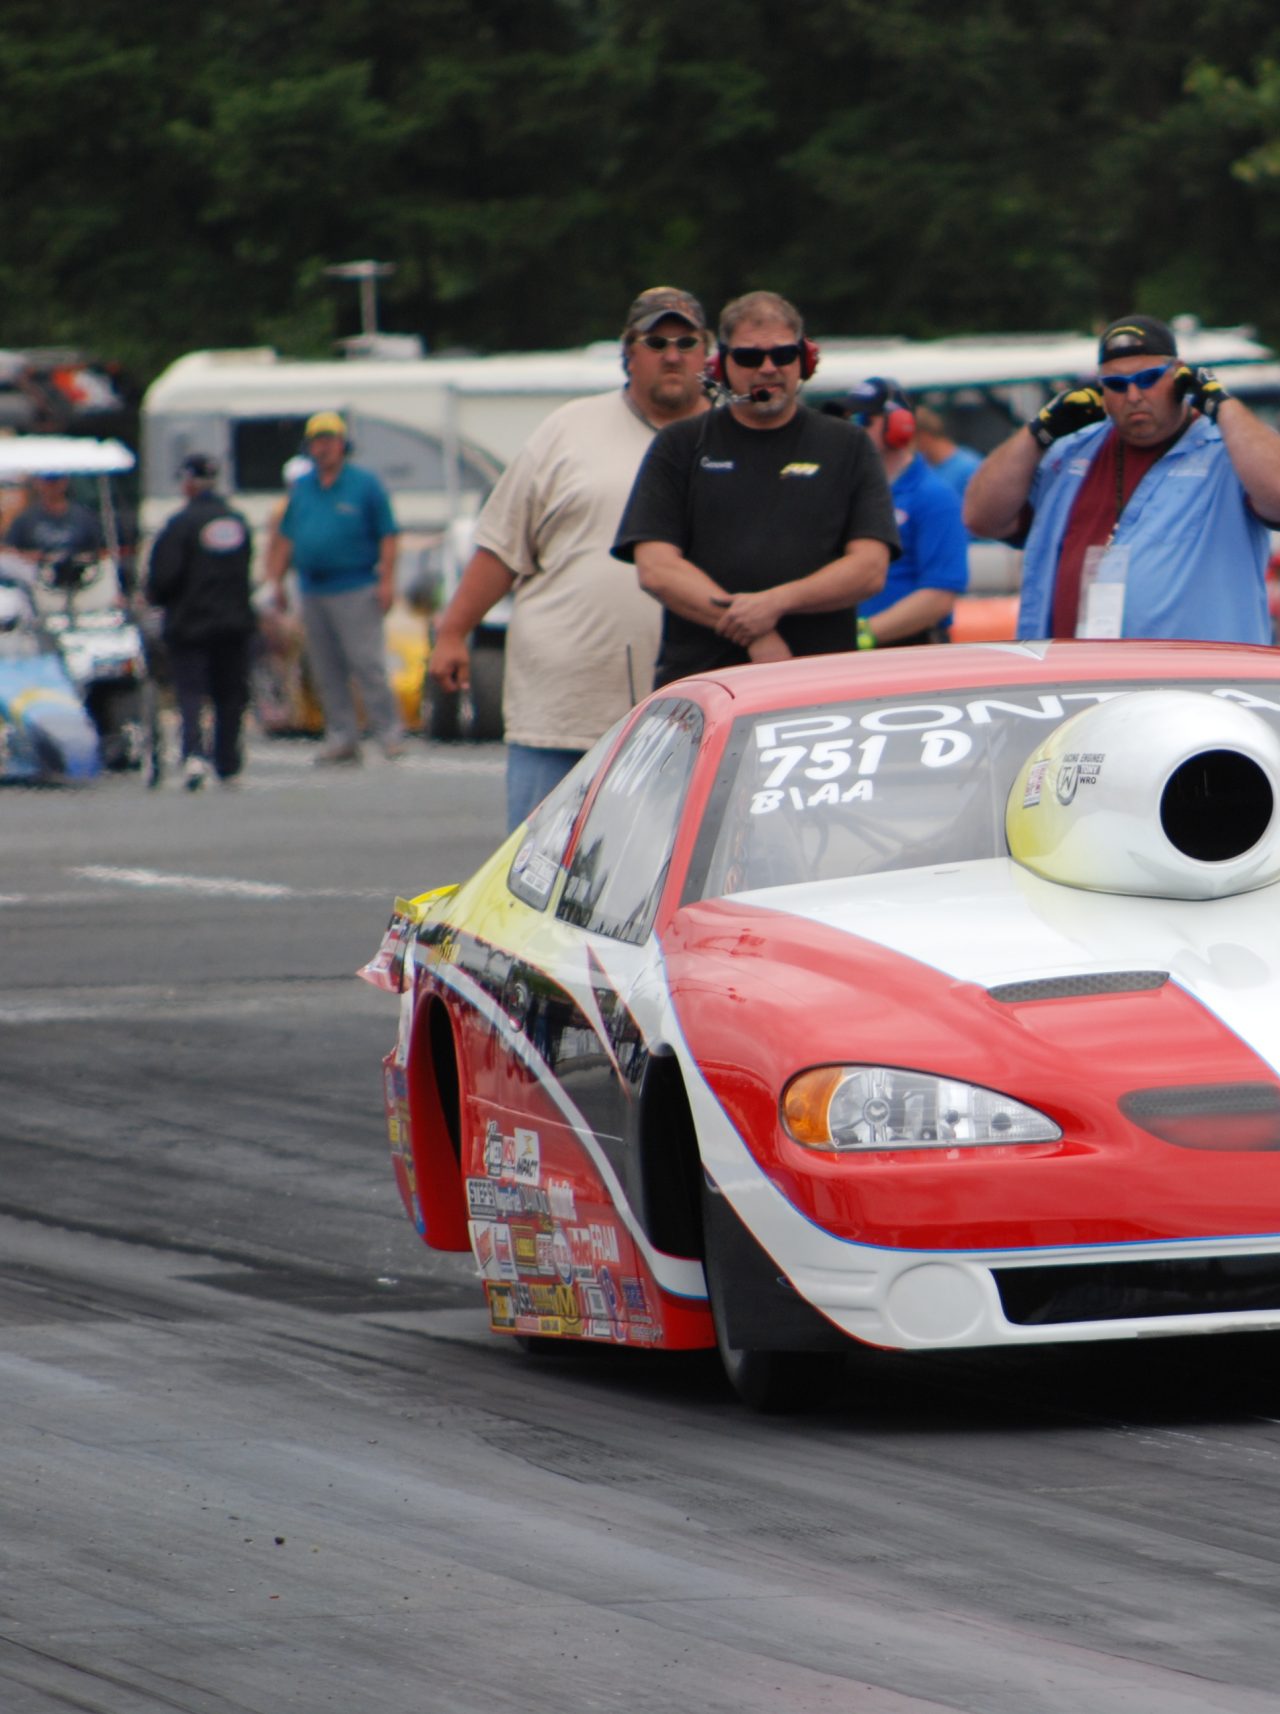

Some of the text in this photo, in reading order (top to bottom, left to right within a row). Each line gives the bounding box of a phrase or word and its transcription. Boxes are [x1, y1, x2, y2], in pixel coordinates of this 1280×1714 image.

[758, 730, 972, 788] 751 D
[589, 1224, 620, 1262] FRAM
